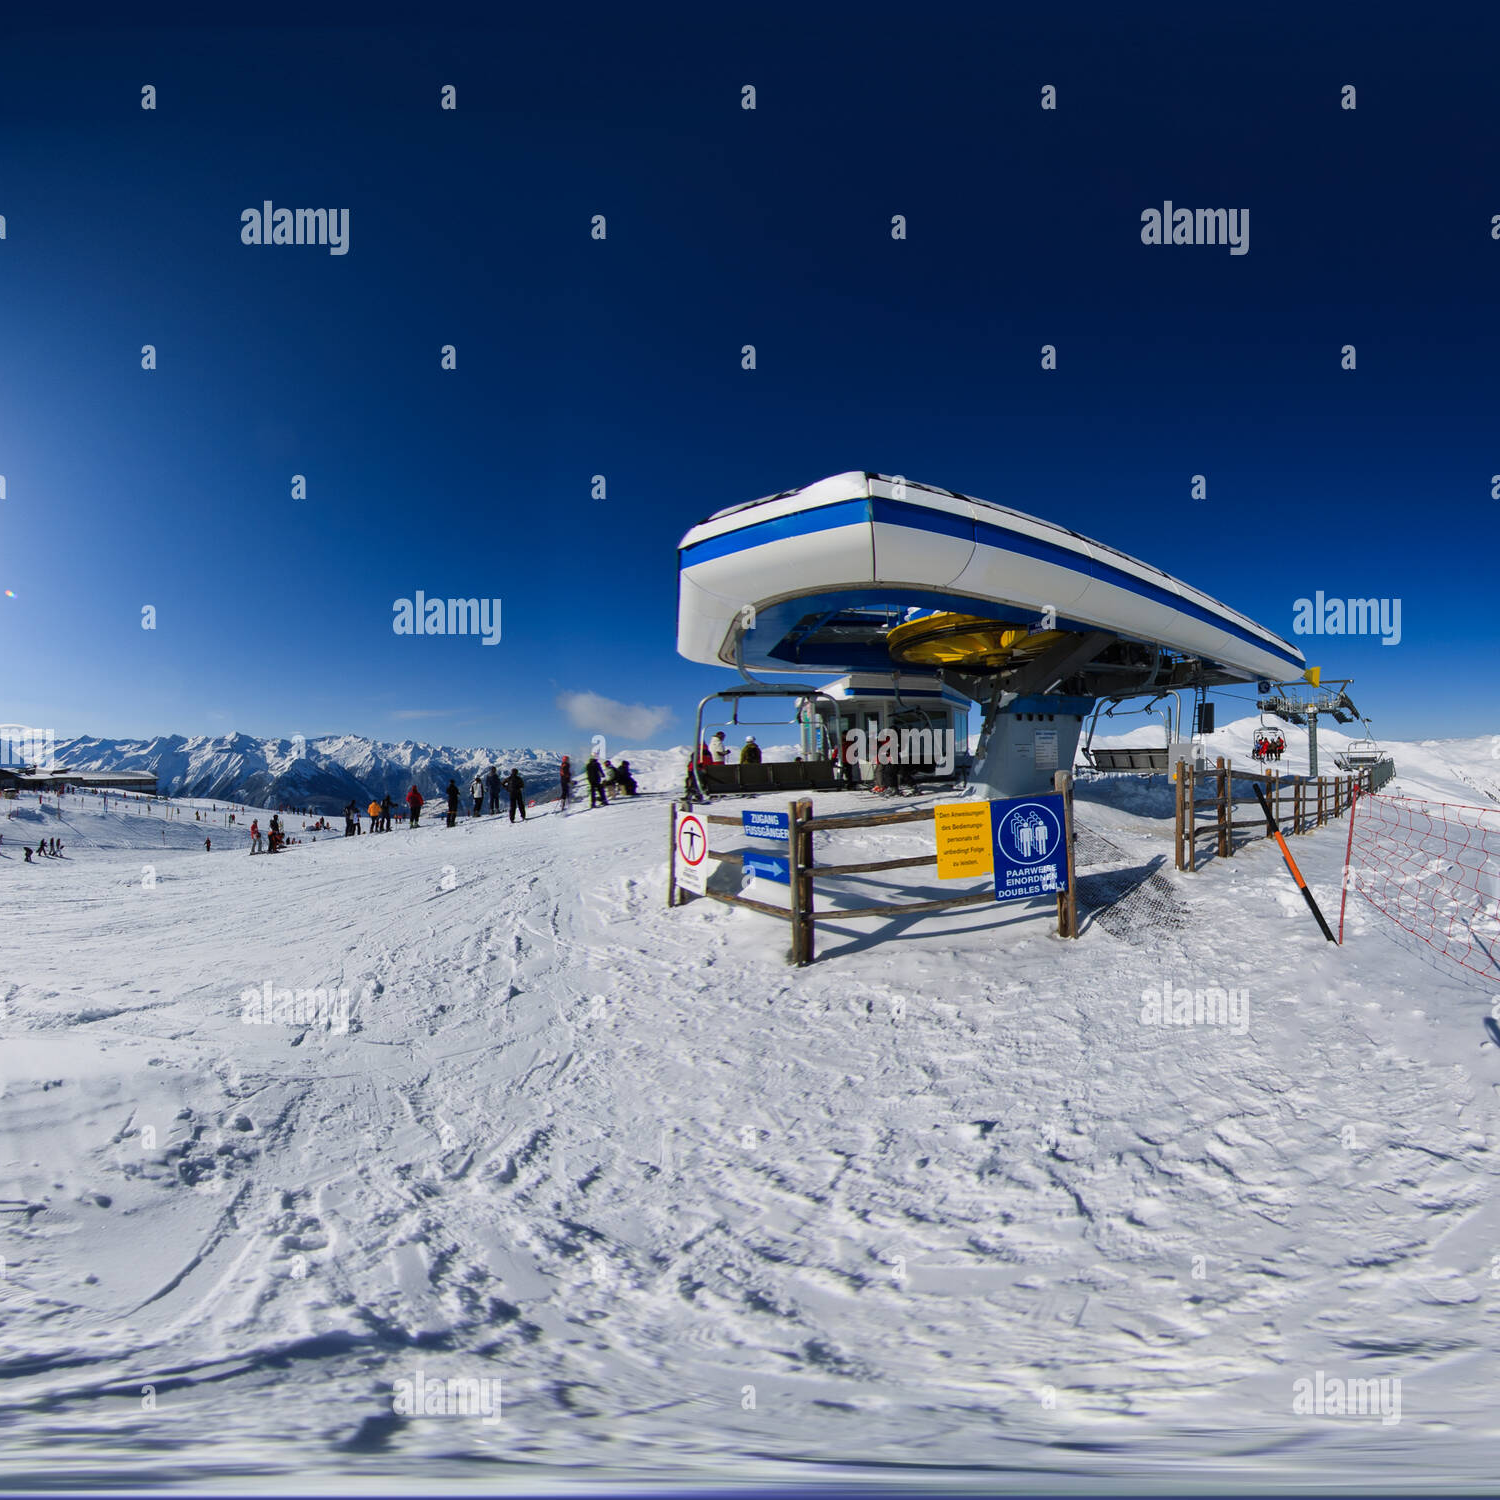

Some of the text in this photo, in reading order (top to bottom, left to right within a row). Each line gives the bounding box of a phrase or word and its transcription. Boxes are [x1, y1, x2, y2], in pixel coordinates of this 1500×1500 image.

[750, 813, 779, 825] ZUGANG
[951, 810, 985, 818] Anweisungen
[745, 825, 789, 839] FUSSGÄNGER
[943, 847, 969, 855] unbedingt
[1006, 864, 1057, 878] PAARWEISE
[1006, 872, 1058, 887] EINORDNEN
[998, 881, 1065, 898] DOUBLES ONLY
